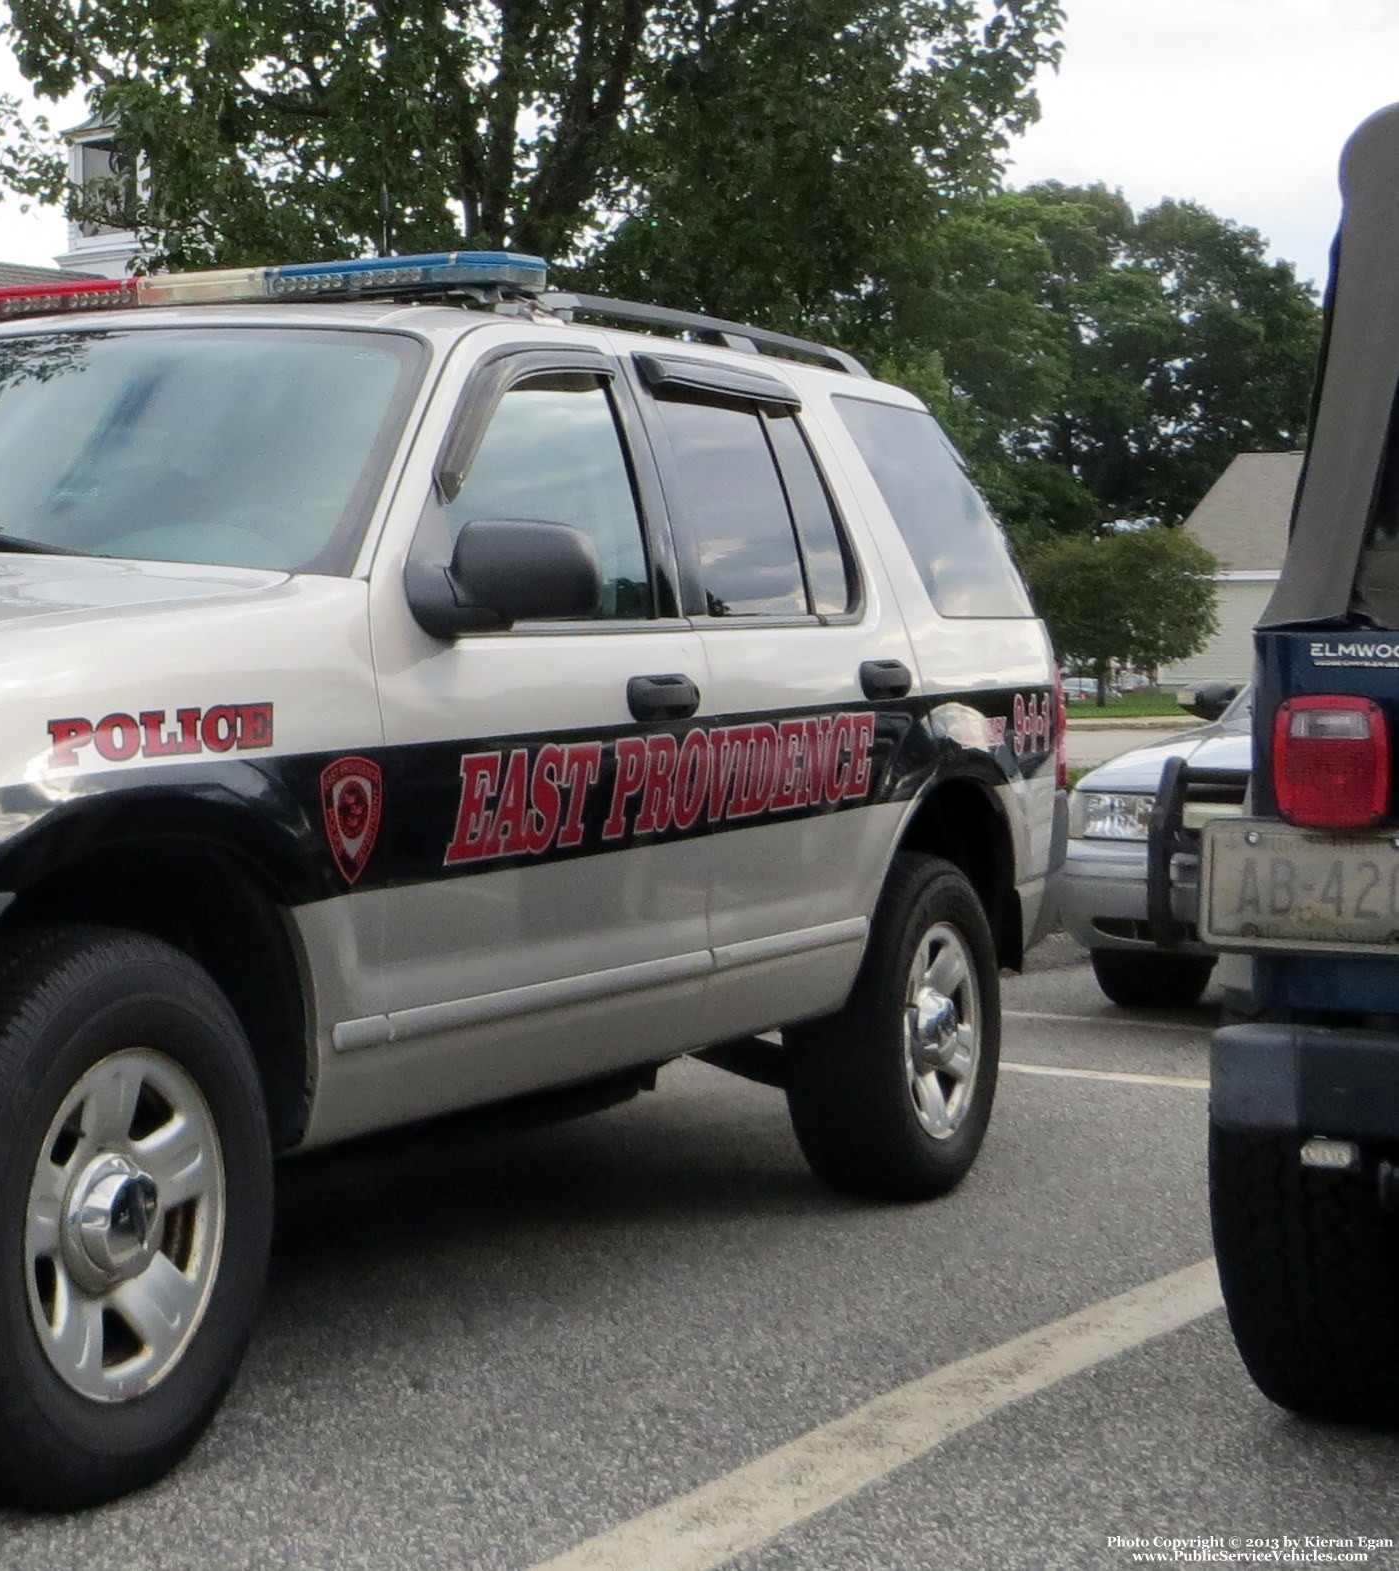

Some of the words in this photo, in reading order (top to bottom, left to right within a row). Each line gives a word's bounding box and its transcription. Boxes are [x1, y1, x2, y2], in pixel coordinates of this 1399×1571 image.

[47, 702, 274, 769] POLICE
[443, 741, 602, 866] EAST
[602, 711, 876, 840] PROVIDENCE
